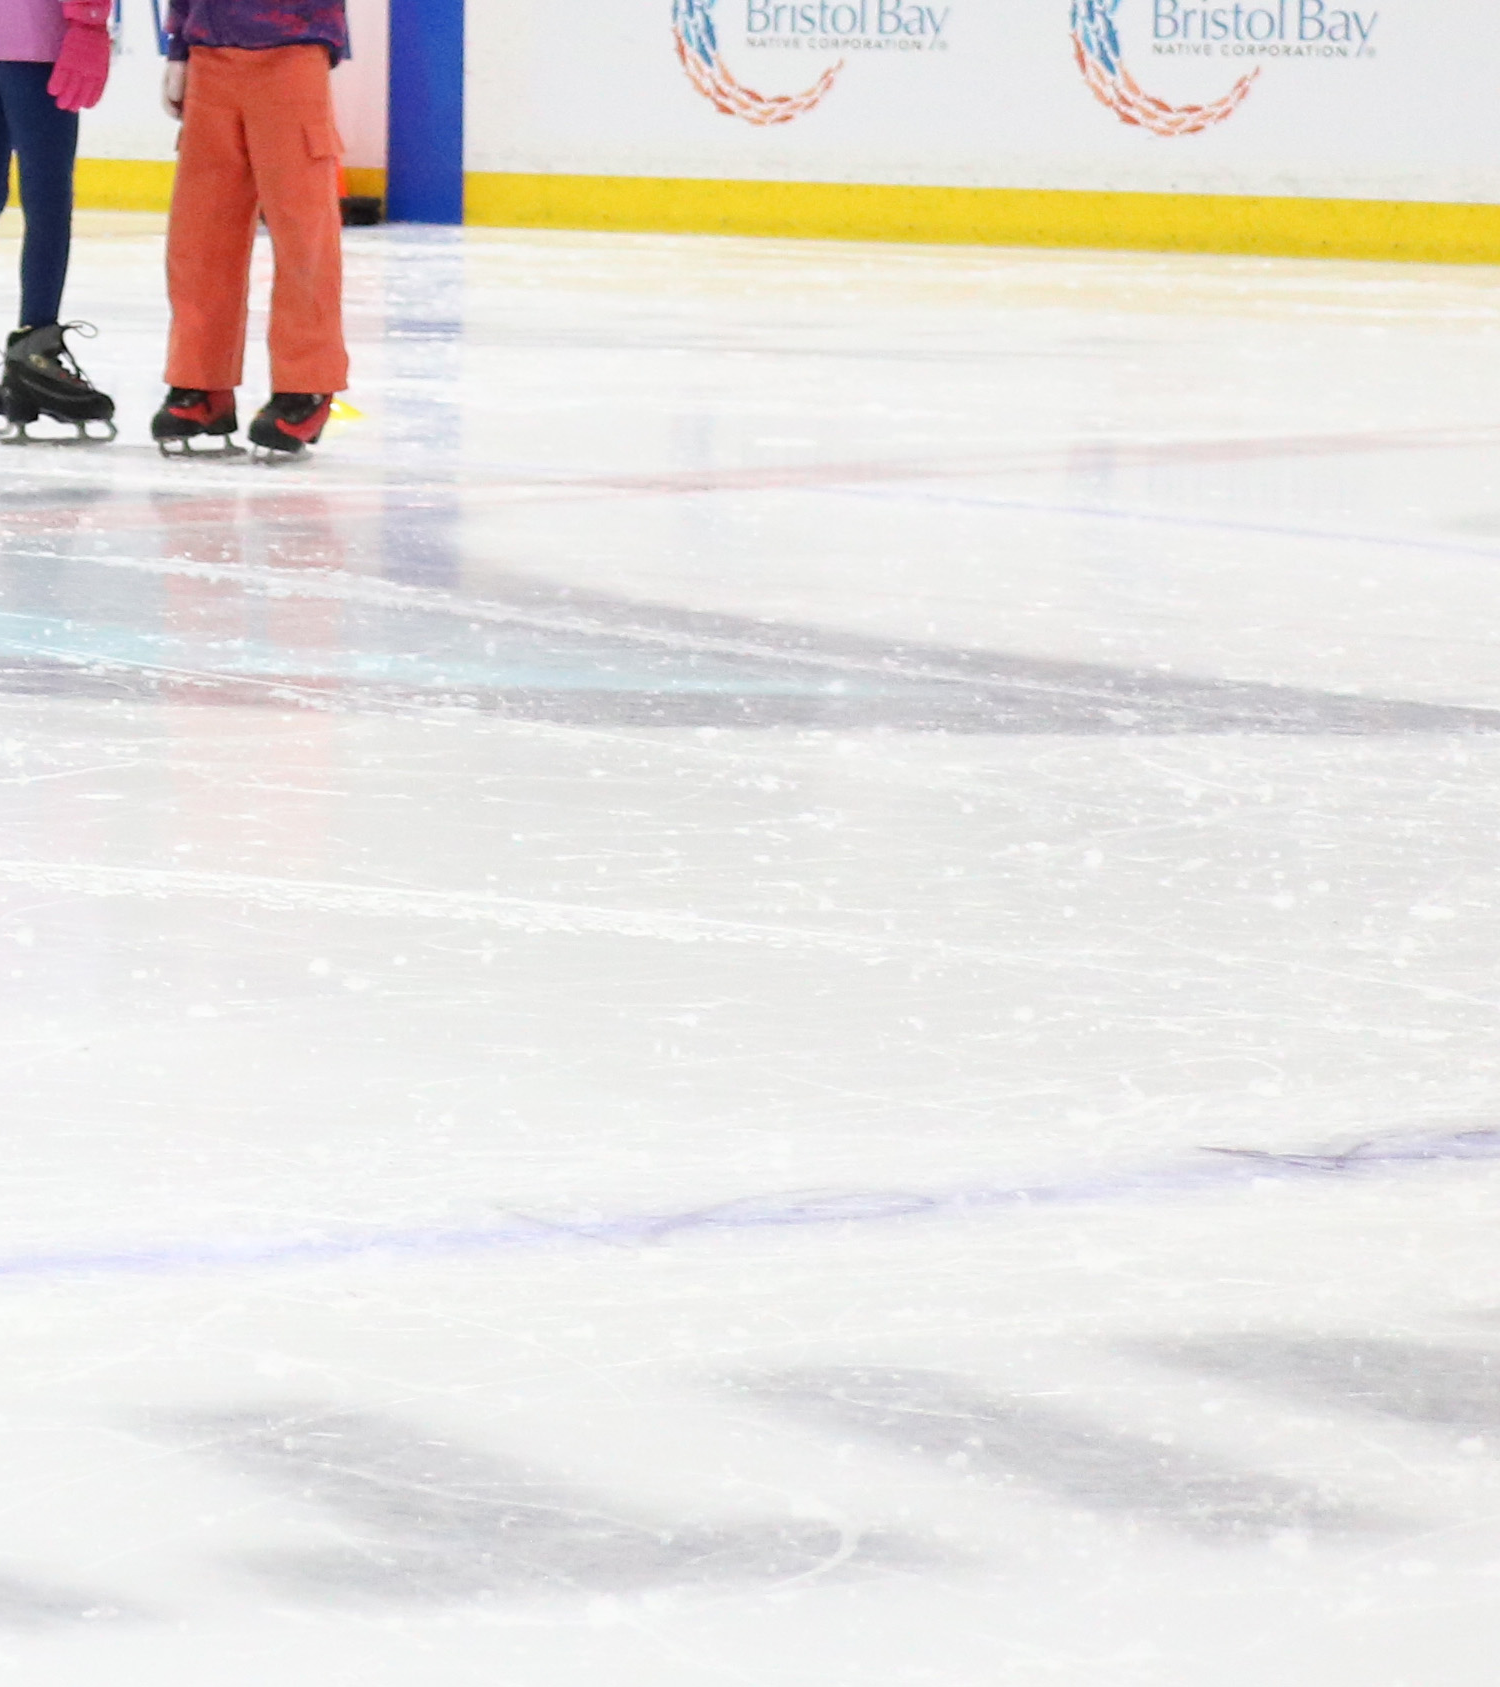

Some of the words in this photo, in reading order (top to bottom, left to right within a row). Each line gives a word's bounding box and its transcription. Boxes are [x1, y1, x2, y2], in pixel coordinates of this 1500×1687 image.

[747, 37, 800, 49] NATIVE
[808, 37, 922, 50] CORPORATION
[1153, 44, 1212, 56] NATIVE
[1220, 44, 1348, 57] CORPORATION
